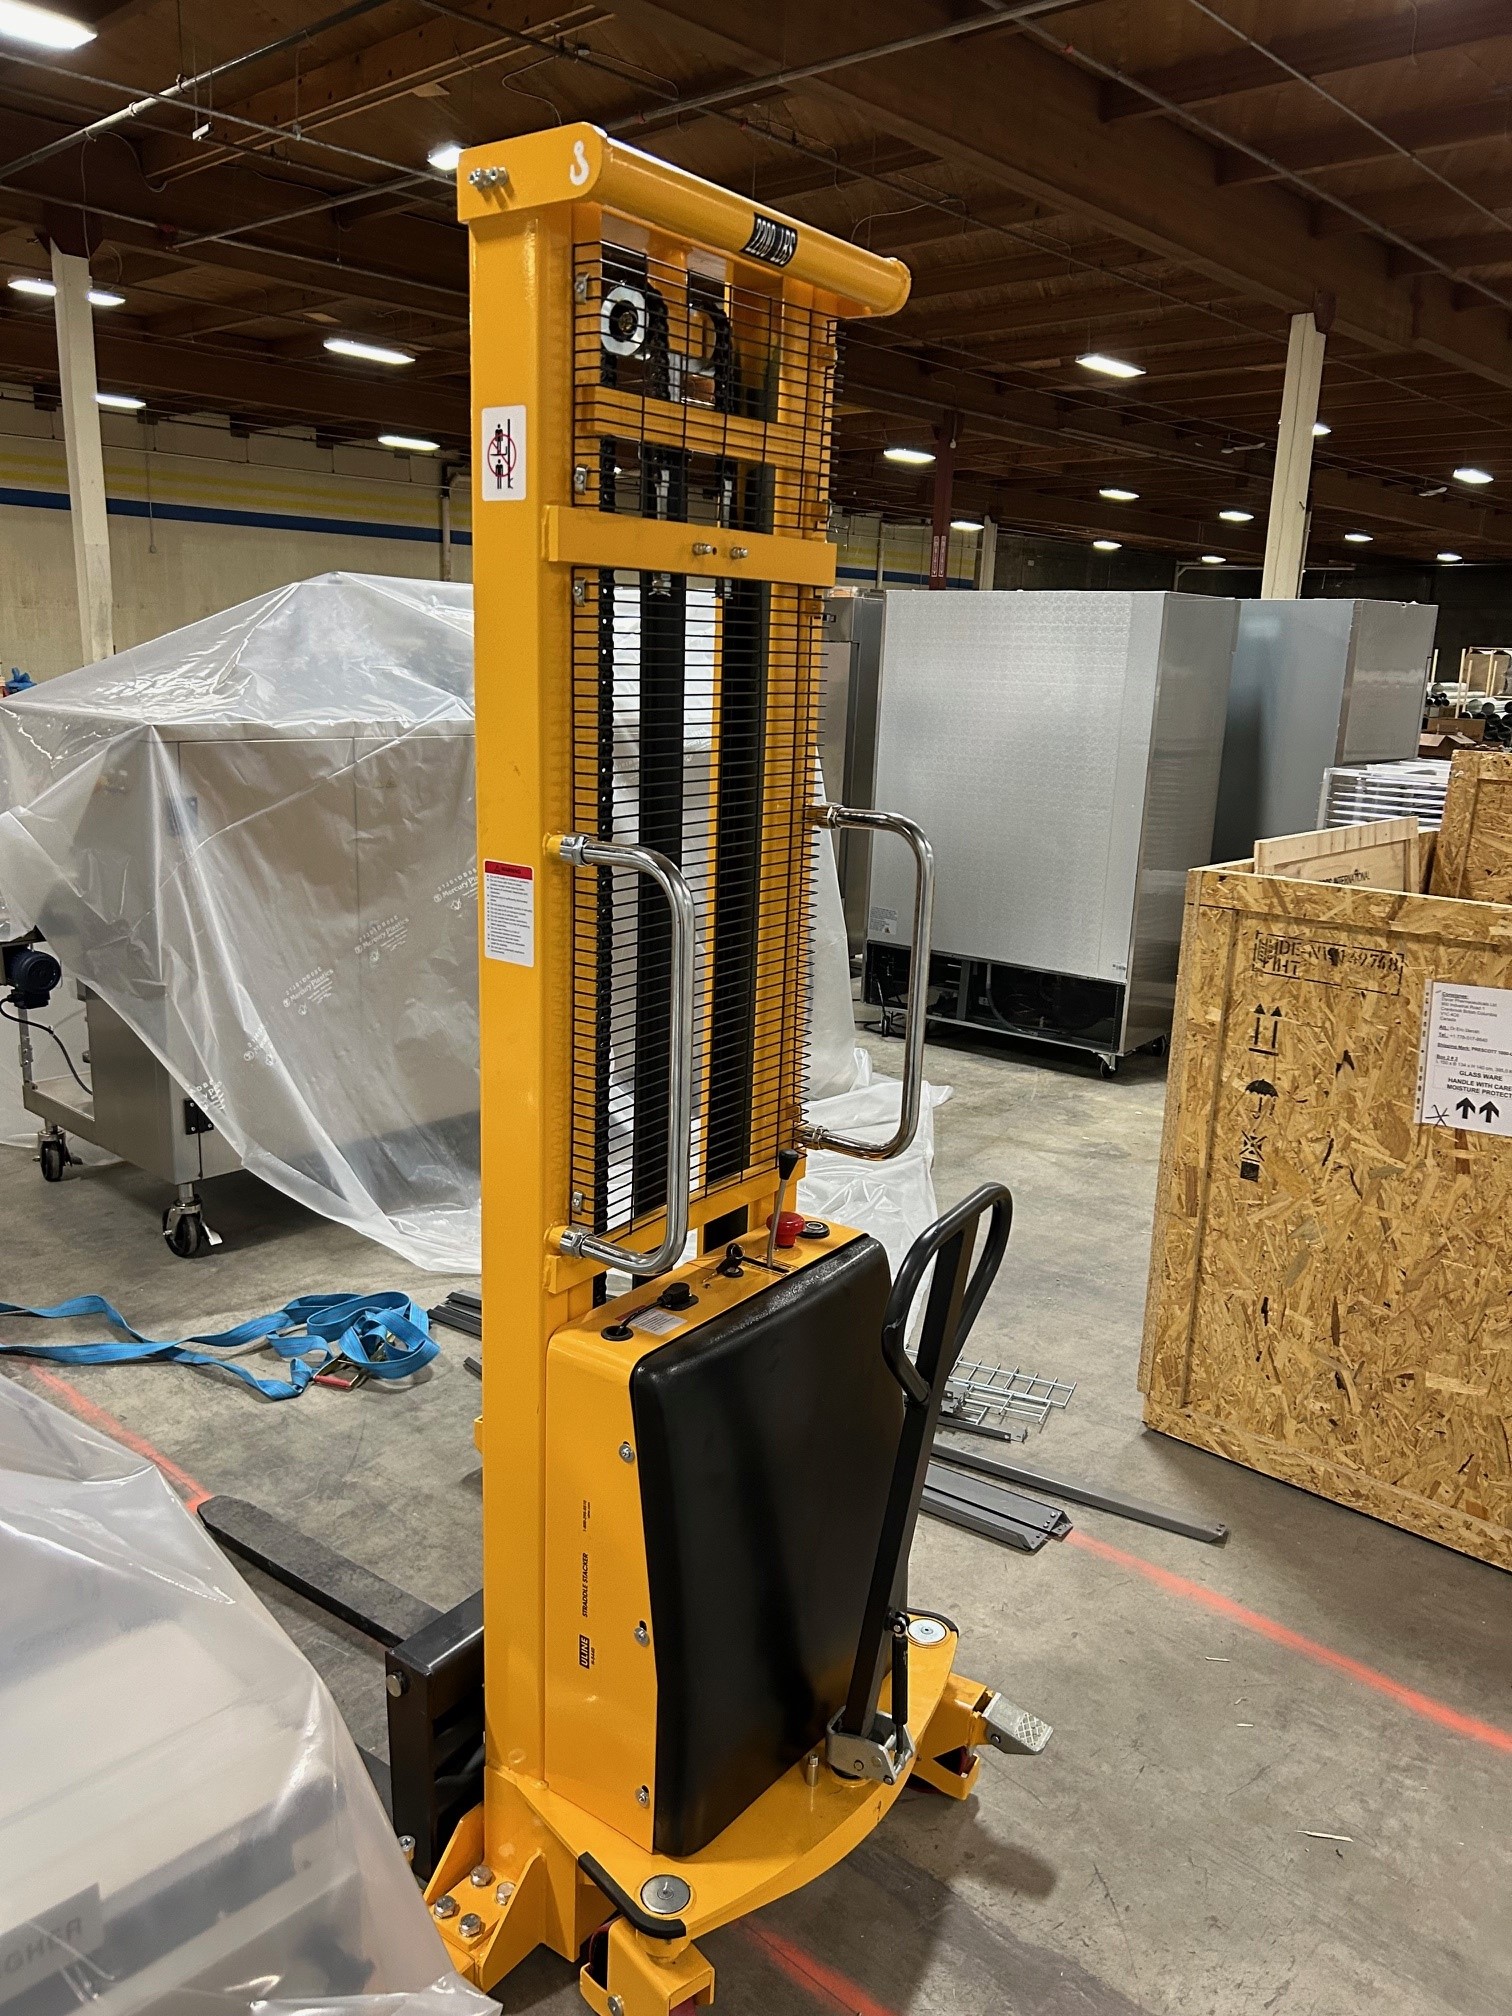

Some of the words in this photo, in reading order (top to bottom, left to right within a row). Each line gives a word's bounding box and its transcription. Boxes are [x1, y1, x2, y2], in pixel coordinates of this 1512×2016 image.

[441, 880, 469, 899] Mercury
[1459, 1070, 1482, 1079] GLASS
[1483, 1073, 1503, 1082] WARE
[1447, 1084, 1480, 1094] MOISTURE
[1448, 1077, 1475, 1087] HANDLE
[1476, 1081, 1493, 1089] WITH
[1494, 1084, 1512, 1092] CARE
[580, 1636, 589, 1667] ULINE
